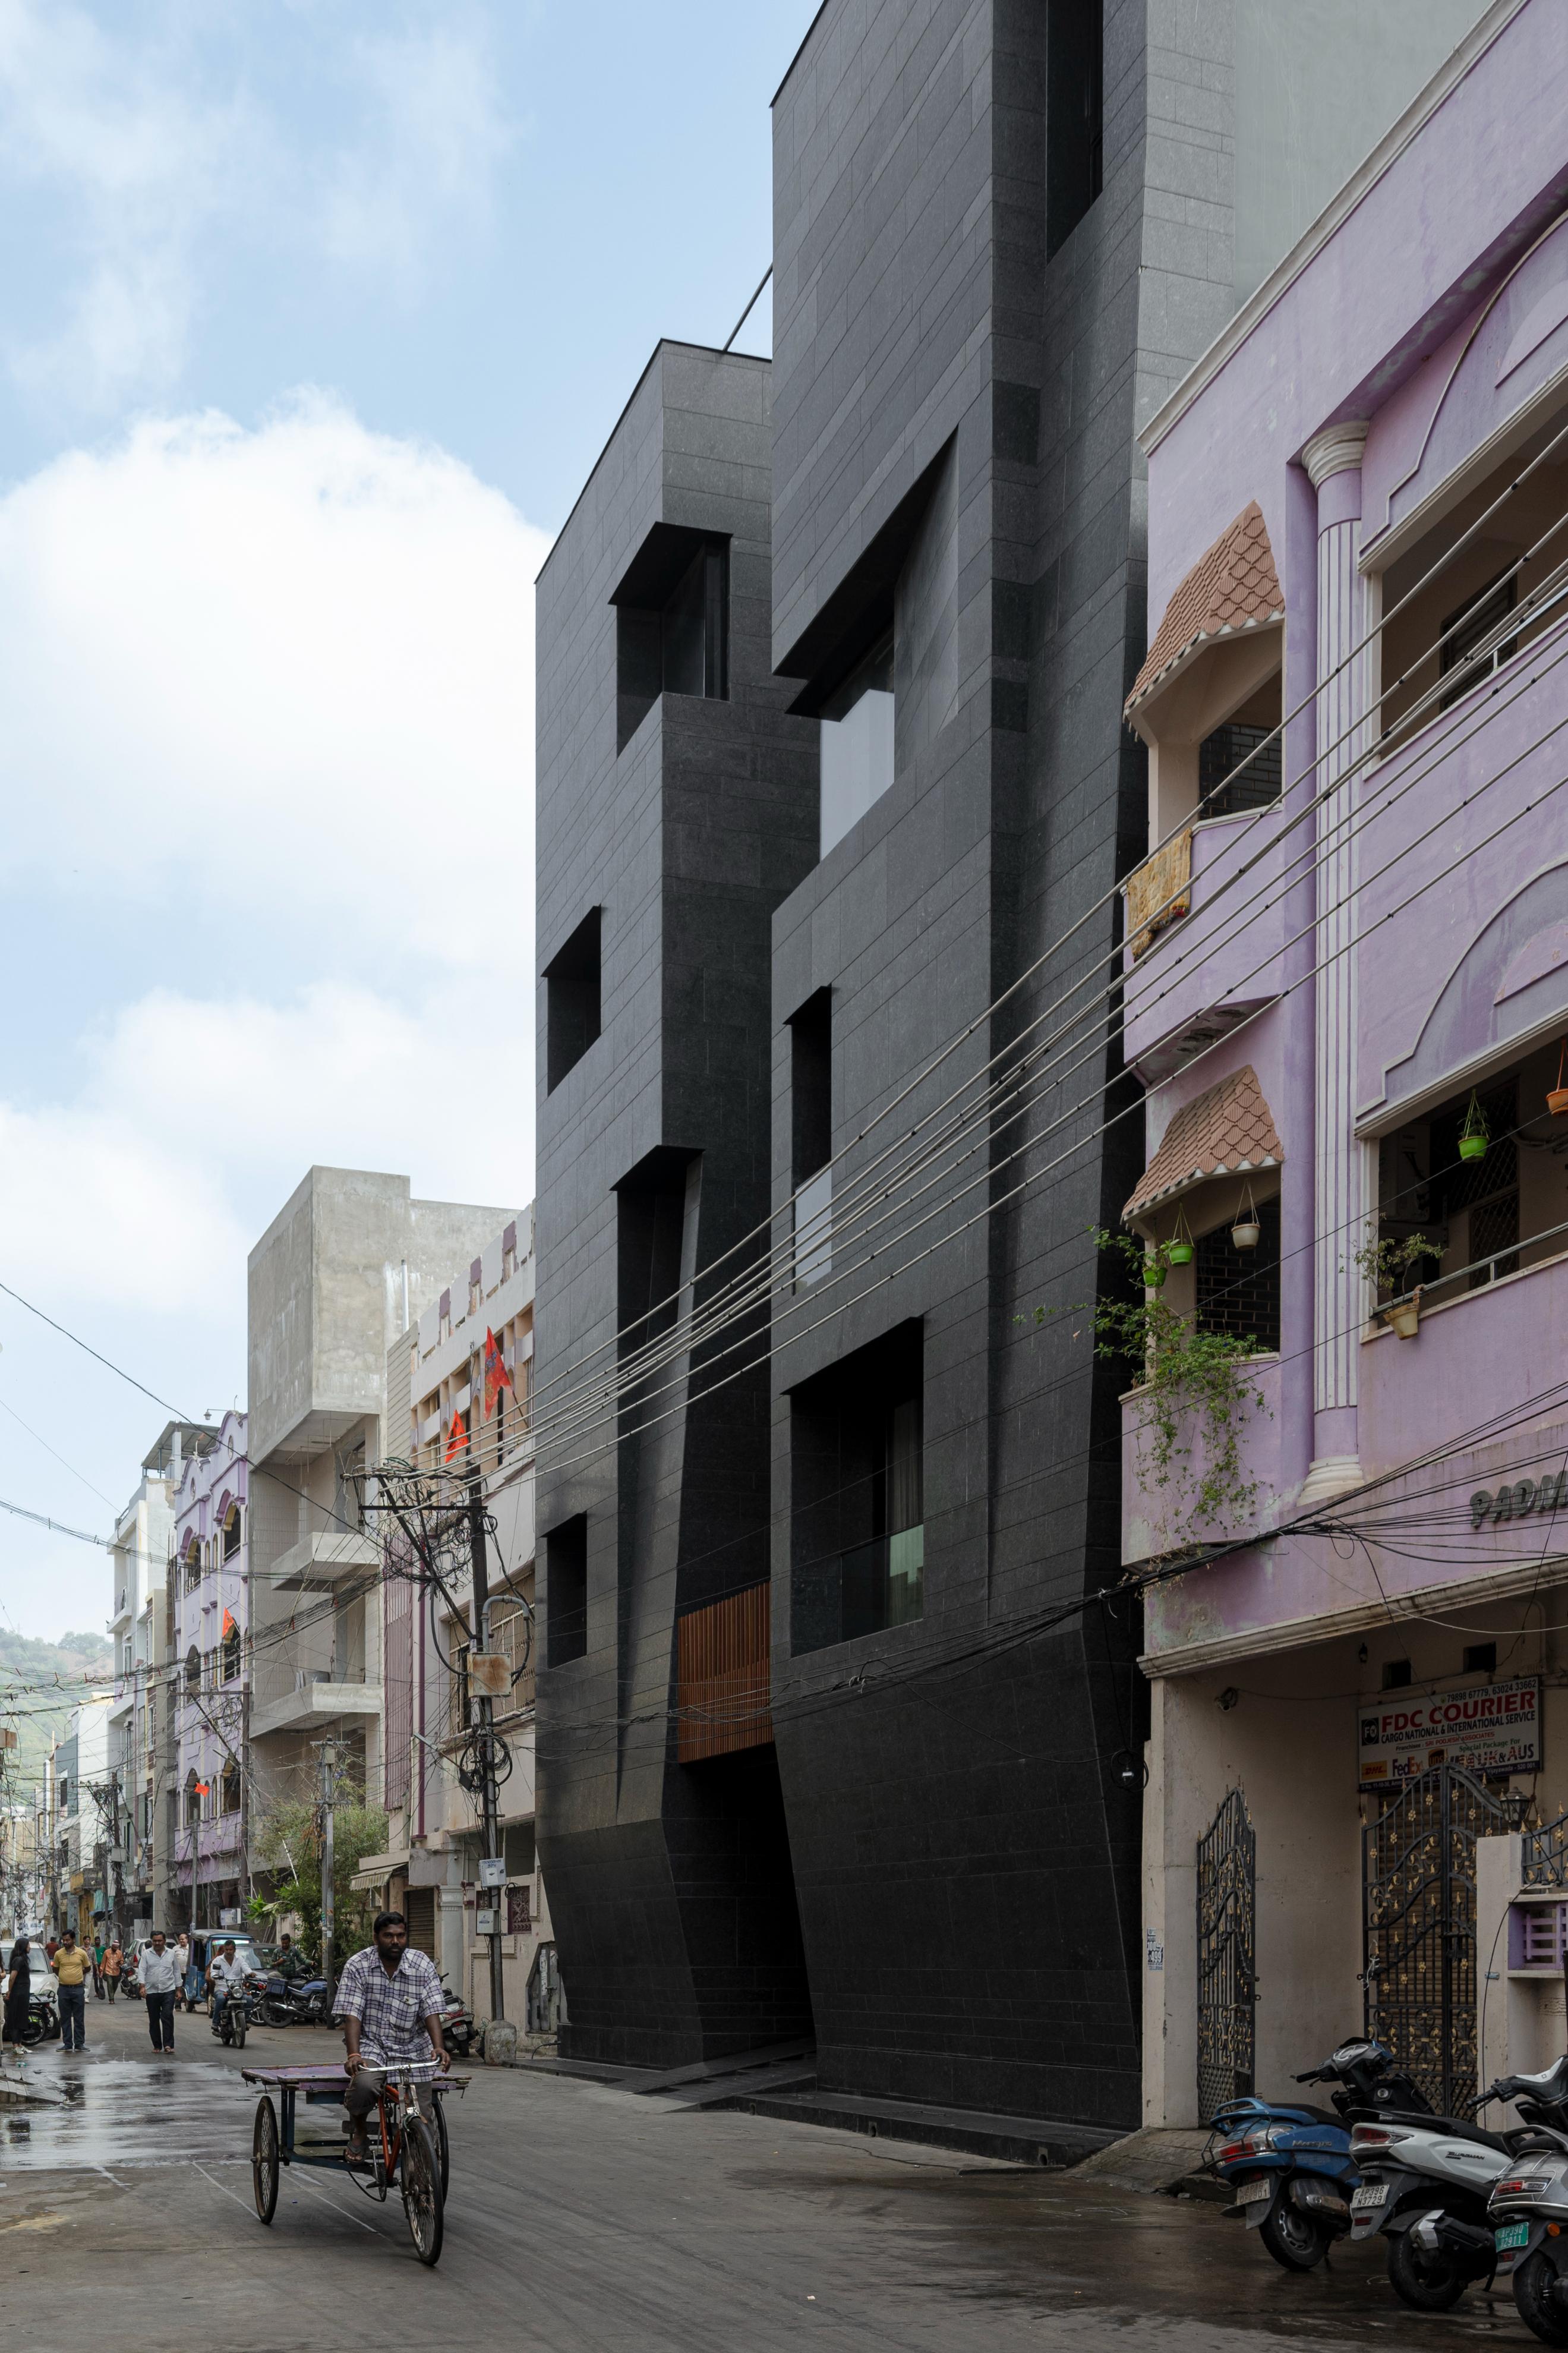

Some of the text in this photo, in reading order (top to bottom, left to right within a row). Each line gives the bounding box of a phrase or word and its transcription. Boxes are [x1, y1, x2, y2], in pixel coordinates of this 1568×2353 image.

[1447, 1692, 1466, 1703] 79898
[1493, 1684, 1513, 1695] 63024
[1516, 1679, 1537, 1690] 33662
[1381, 1690, 1535, 1733] FDC COURIER
[1381, 1711, 1535, 1744] CARGO NATIONAL & INTERNATIONAL SERVICE
[1461, 1731, 1495, 1741] ASSOCIATES
[1459, 1742, 1481, 1752] Special
[1483, 1739, 1508, 1750] Package
[1507, 1744, 1534, 1762] AUS
[1364, 1766, 1384, 1775] DHL
[1393, 1756, 1421, 1777] FedEx
[1357, 2195, 1383, 2206] N3729
